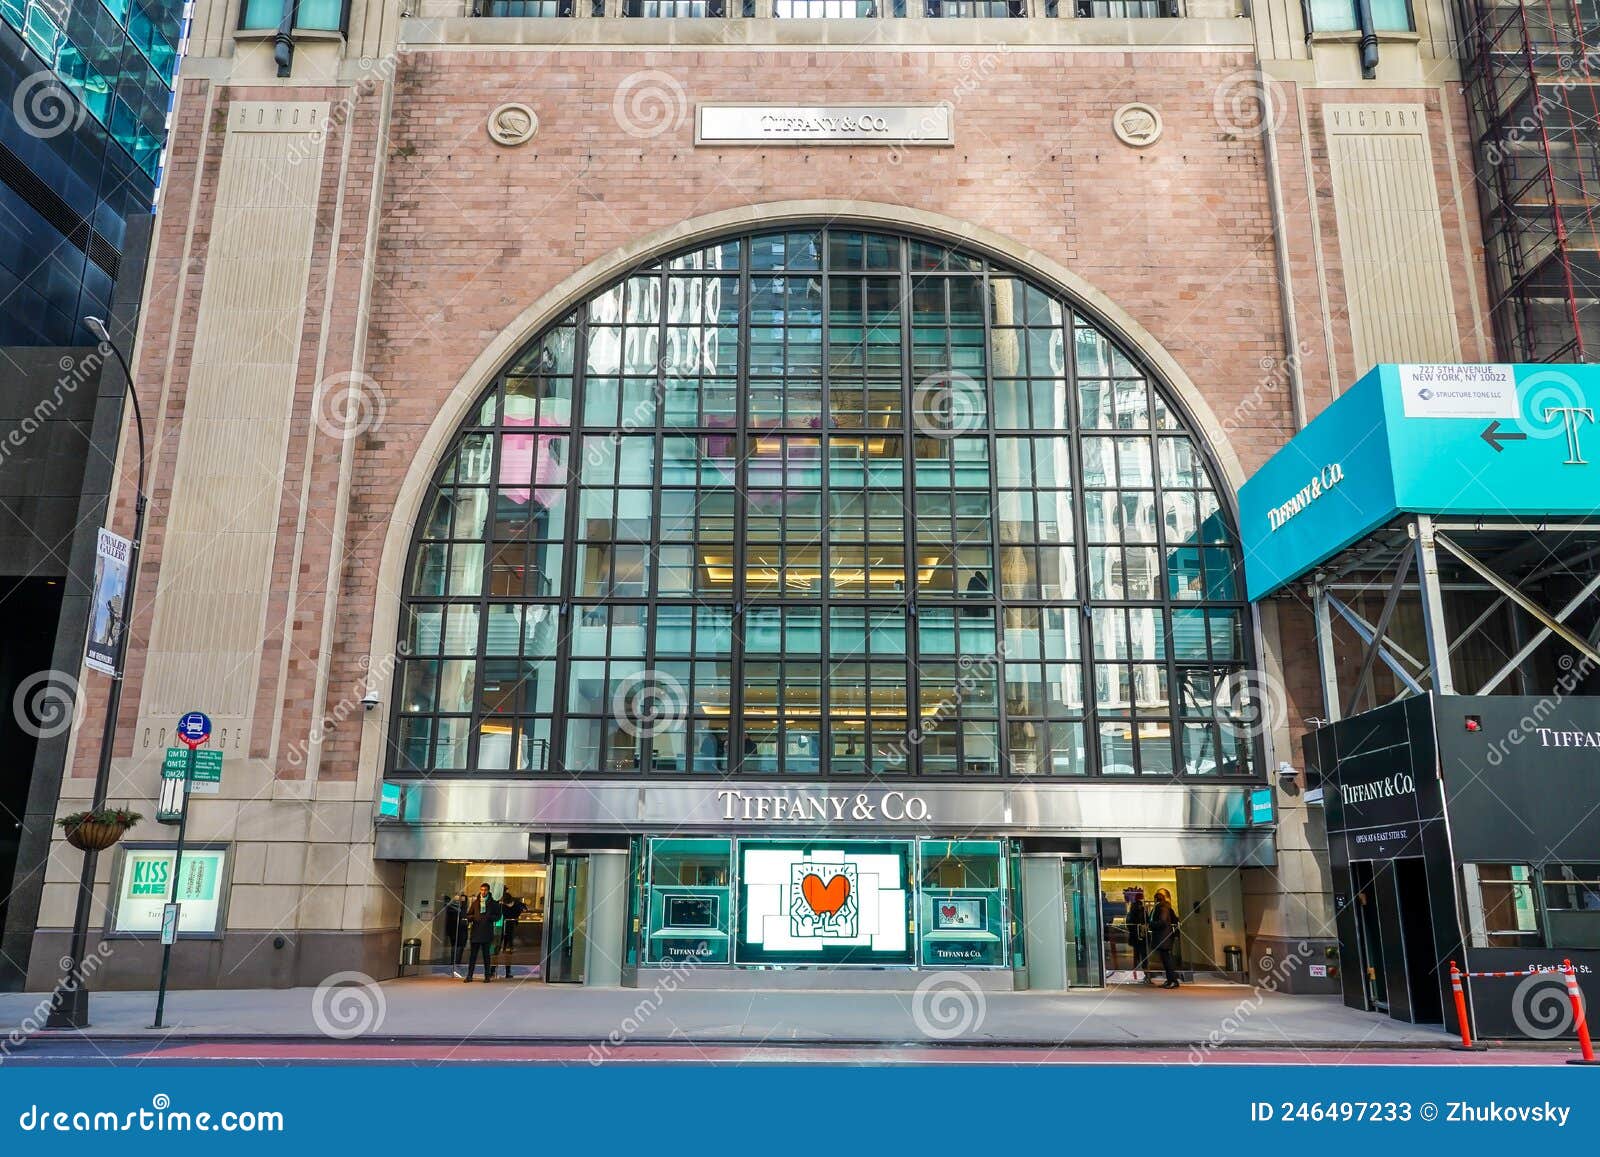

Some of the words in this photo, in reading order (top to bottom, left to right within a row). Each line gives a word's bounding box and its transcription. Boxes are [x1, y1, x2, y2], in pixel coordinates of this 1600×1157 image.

[760, 115, 839, 132] TIFFANY
[1333, 110, 1418, 127] VICTORY
[1419, 366, 1435, 374] 727
[1438, 366, 1454, 374] 5TH
[1457, 366, 1493, 374] AVENUE
[1437, 374, 1463, 382] YORK,
[1480, 374, 1506, 382] 10022
[1267, 484, 1312, 532] TIFFANY
[1311, 477, 1322, 499] &
[143, 727, 241, 748] COUGE
[168, 750, 188, 758] QM10
[167, 760, 187, 768] QM12
[165, 770, 185, 778] QM24
[1341, 780, 1384, 805] TIFFANY
[1384, 776, 1395, 797] &
[718, 791, 848, 821] TIFFANY
[852, 794, 875, 821] &
[1355, 834, 1368, 844] OPEN
[134, 861, 169, 883] KISS
[131, 883, 166, 895] ME
[937, 949, 964, 958] TIFFANY
[1537, 964, 1555, 973] East
[1580, 964, 1593, 974] St.
